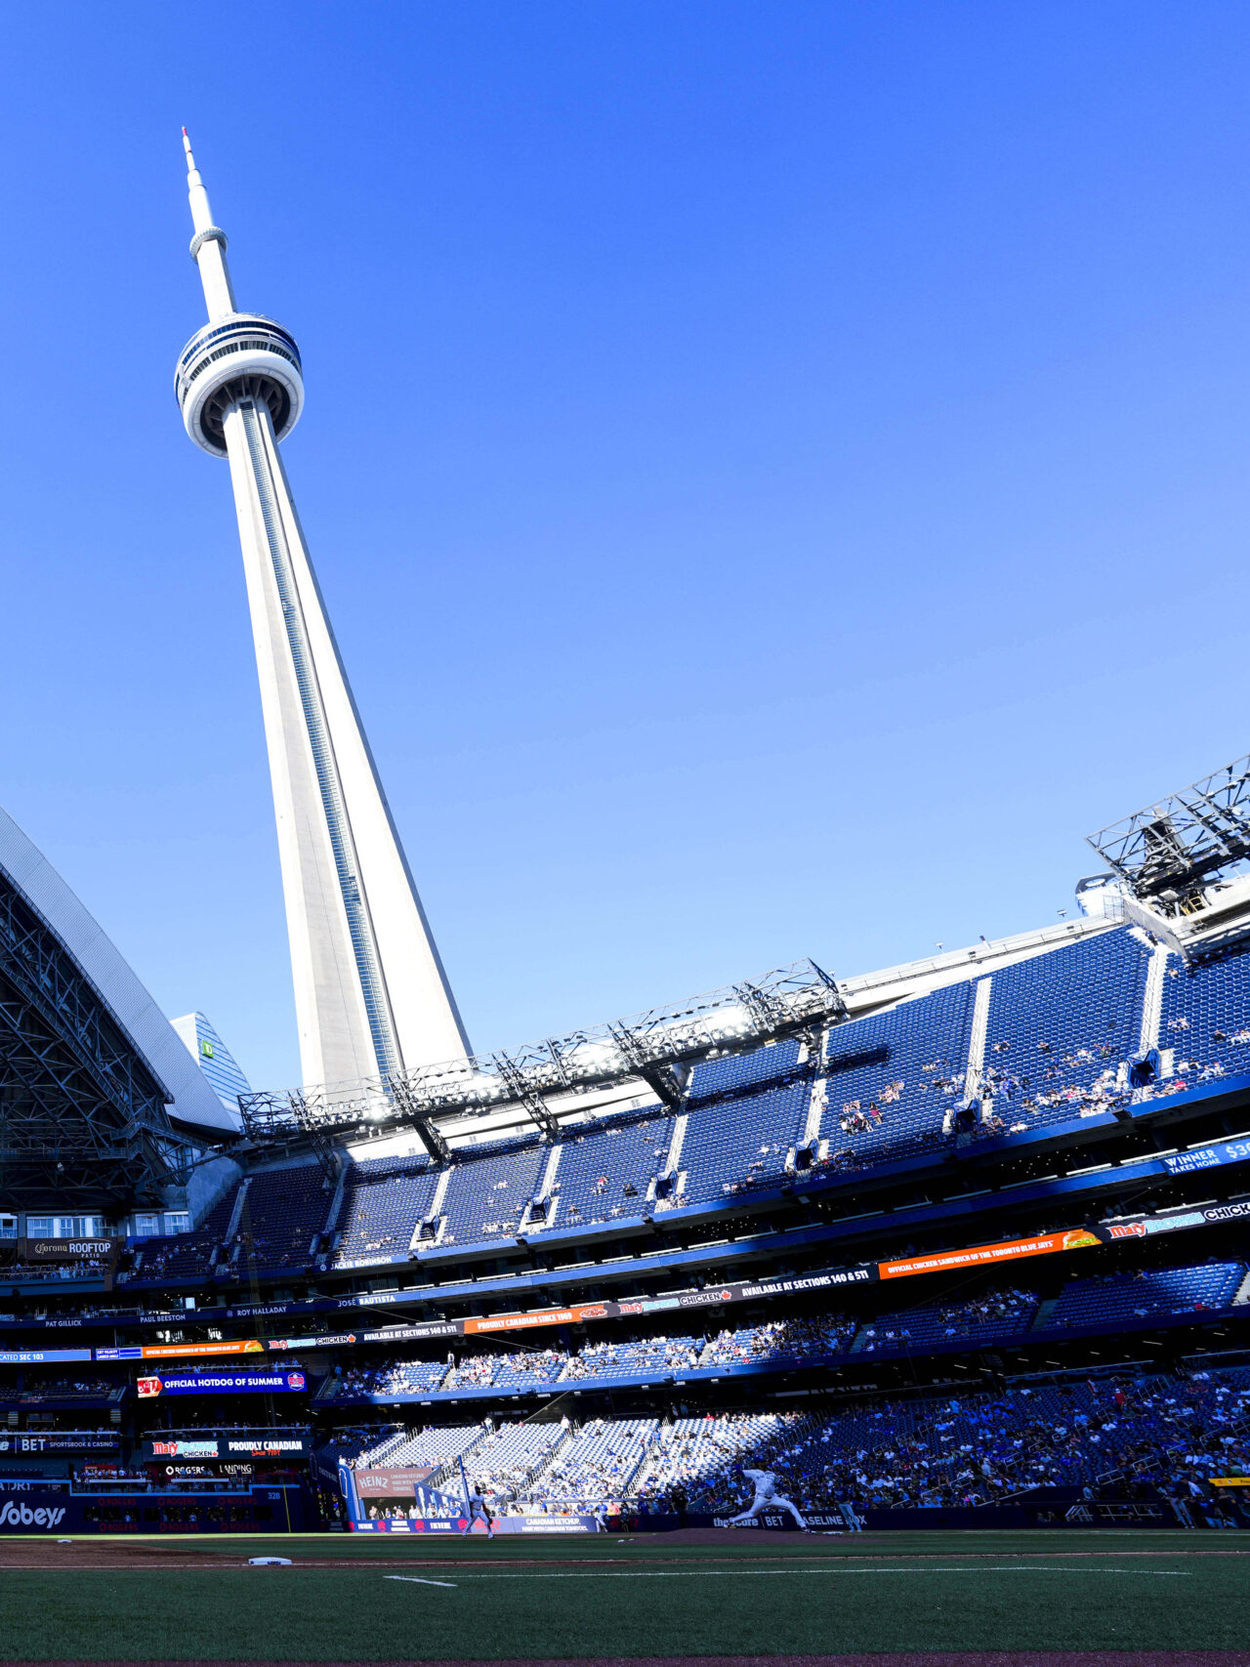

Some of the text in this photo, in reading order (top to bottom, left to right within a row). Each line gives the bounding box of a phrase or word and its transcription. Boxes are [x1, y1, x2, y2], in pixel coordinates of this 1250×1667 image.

[1164, 1148, 1218, 1168] WINNER
[1168, 1157, 1223, 1174] TAKES HOME
[1105, 1222, 1147, 1239] Mary
[35, 1242, 111, 1255] Corona ROOFTOP
[354, 1256, 393, 1269] ROBINSON
[887, 1263, 914, 1274] OFFICIAL
[913, 1259, 938, 1270] CHICKEN
[938, 1254, 970, 1266] SANDWICH
[970, 1252, 979, 1261] OF
[979, 1250, 992, 1260] THE
[992, 1245, 1021, 1258] TORONTO
[1021, 1242, 1038, 1253] BLUE
[618, 1302, 643, 1315] Mary
[680, 1291, 721, 1306] CHICKEN
[741, 1281, 783, 1297] AVAILABLE
[783, 1280, 794, 1291] AT
[794, 1275, 831, 1290] SECTIONS
[831, 1272, 847, 1284] 140
[854, 1269, 869, 1281] 511
[358, 1295, 396, 1306] BAUTISTA
[252, 1306, 287, 1316] HALLADAY
[57, 1320, 82, 1328] GILLICK
[140, 1313, 186, 1324] PAUL BEESTON
[477, 1313, 556, 1331] PROUDLY CANADIAN SINCE
[316, 1335, 348, 1346] CHICKEN
[363, 1331, 394, 1342] AVAILABLE
[394, 1330, 402, 1339] AT
[402, 1327, 429, 1338] SECTIONS
[429, 1326, 441, 1336] 140
[447, 1324, 457, 1334] 511
[20, 1352, 32, 1361] SEC
[32, 1352, 45, 1361] 103
[164, 1378, 197, 1389] OFFICIAL
[198, 1377, 234, 1388] HOTDOG
[234, 1377, 247, 1387] OF
[247, 1377, 284, 1387] SUMMER
[21, 1438, 47, 1452] BET
[50, 1441, 87, 1449] SPORTSBOOK
[93, 1441, 114, 1449] CASINO
[152, 1441, 178, 1458] Mary
[228, 1440, 303, 1451] PROUDLY CANADIAN
[183, 1450, 212, 1458] CHICKEN
[359, 1476, 389, 1489] HEINZ
[267, 1491, 281, 1500] 328
[525, 1517, 554, 1525] CANADIAN
[713, 1516, 759, 1528] thecore
[766, 1515, 784, 1527] BET
[800, 1514, 843, 1527] ASELINE
